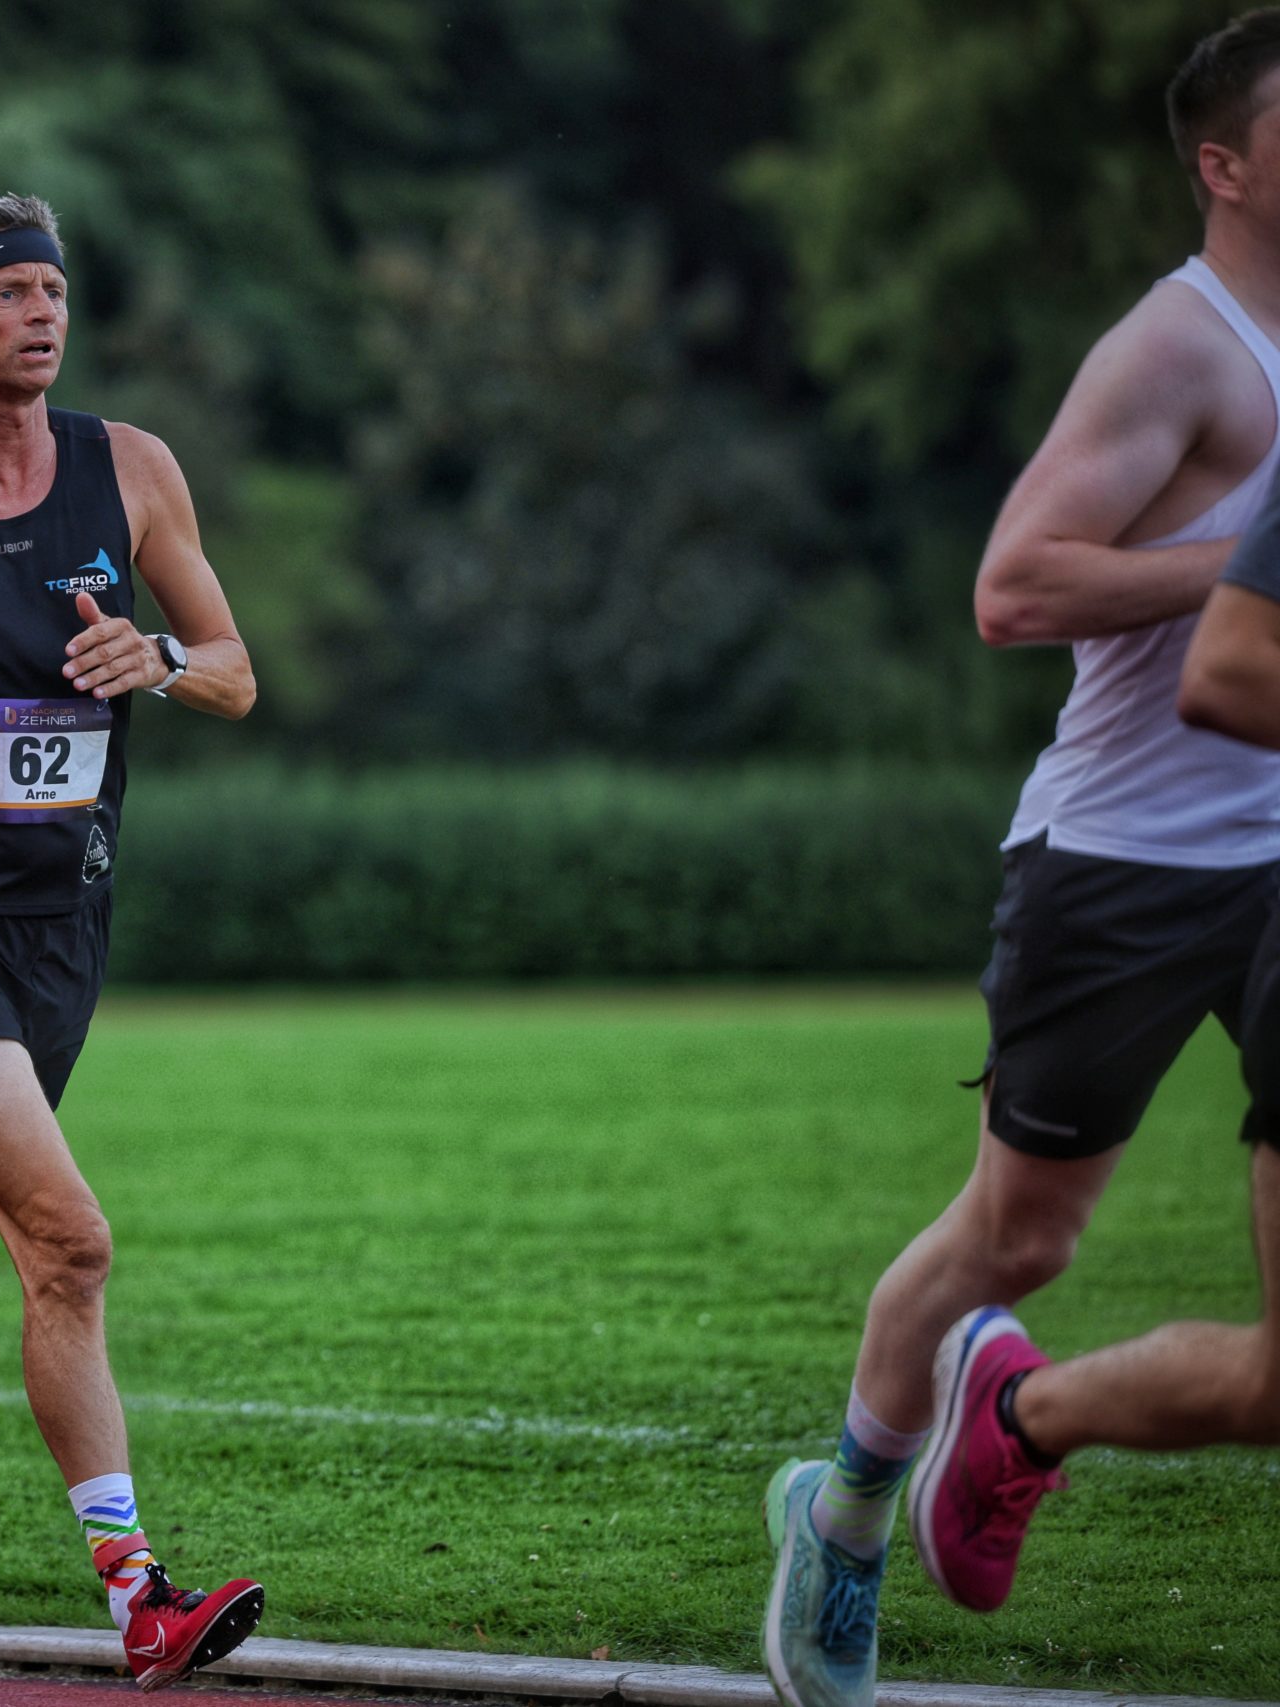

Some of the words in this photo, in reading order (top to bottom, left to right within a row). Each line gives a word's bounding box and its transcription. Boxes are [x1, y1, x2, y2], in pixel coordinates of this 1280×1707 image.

[65, 584, 108, 595] ROSTOCK
[31, 707, 57, 715] NACHT
[59, 707, 75, 715] DER
[20, 715, 77, 725] ZEHNER
[9, 735, 71, 786] 62
[25, 788, 57, 800] Arne
